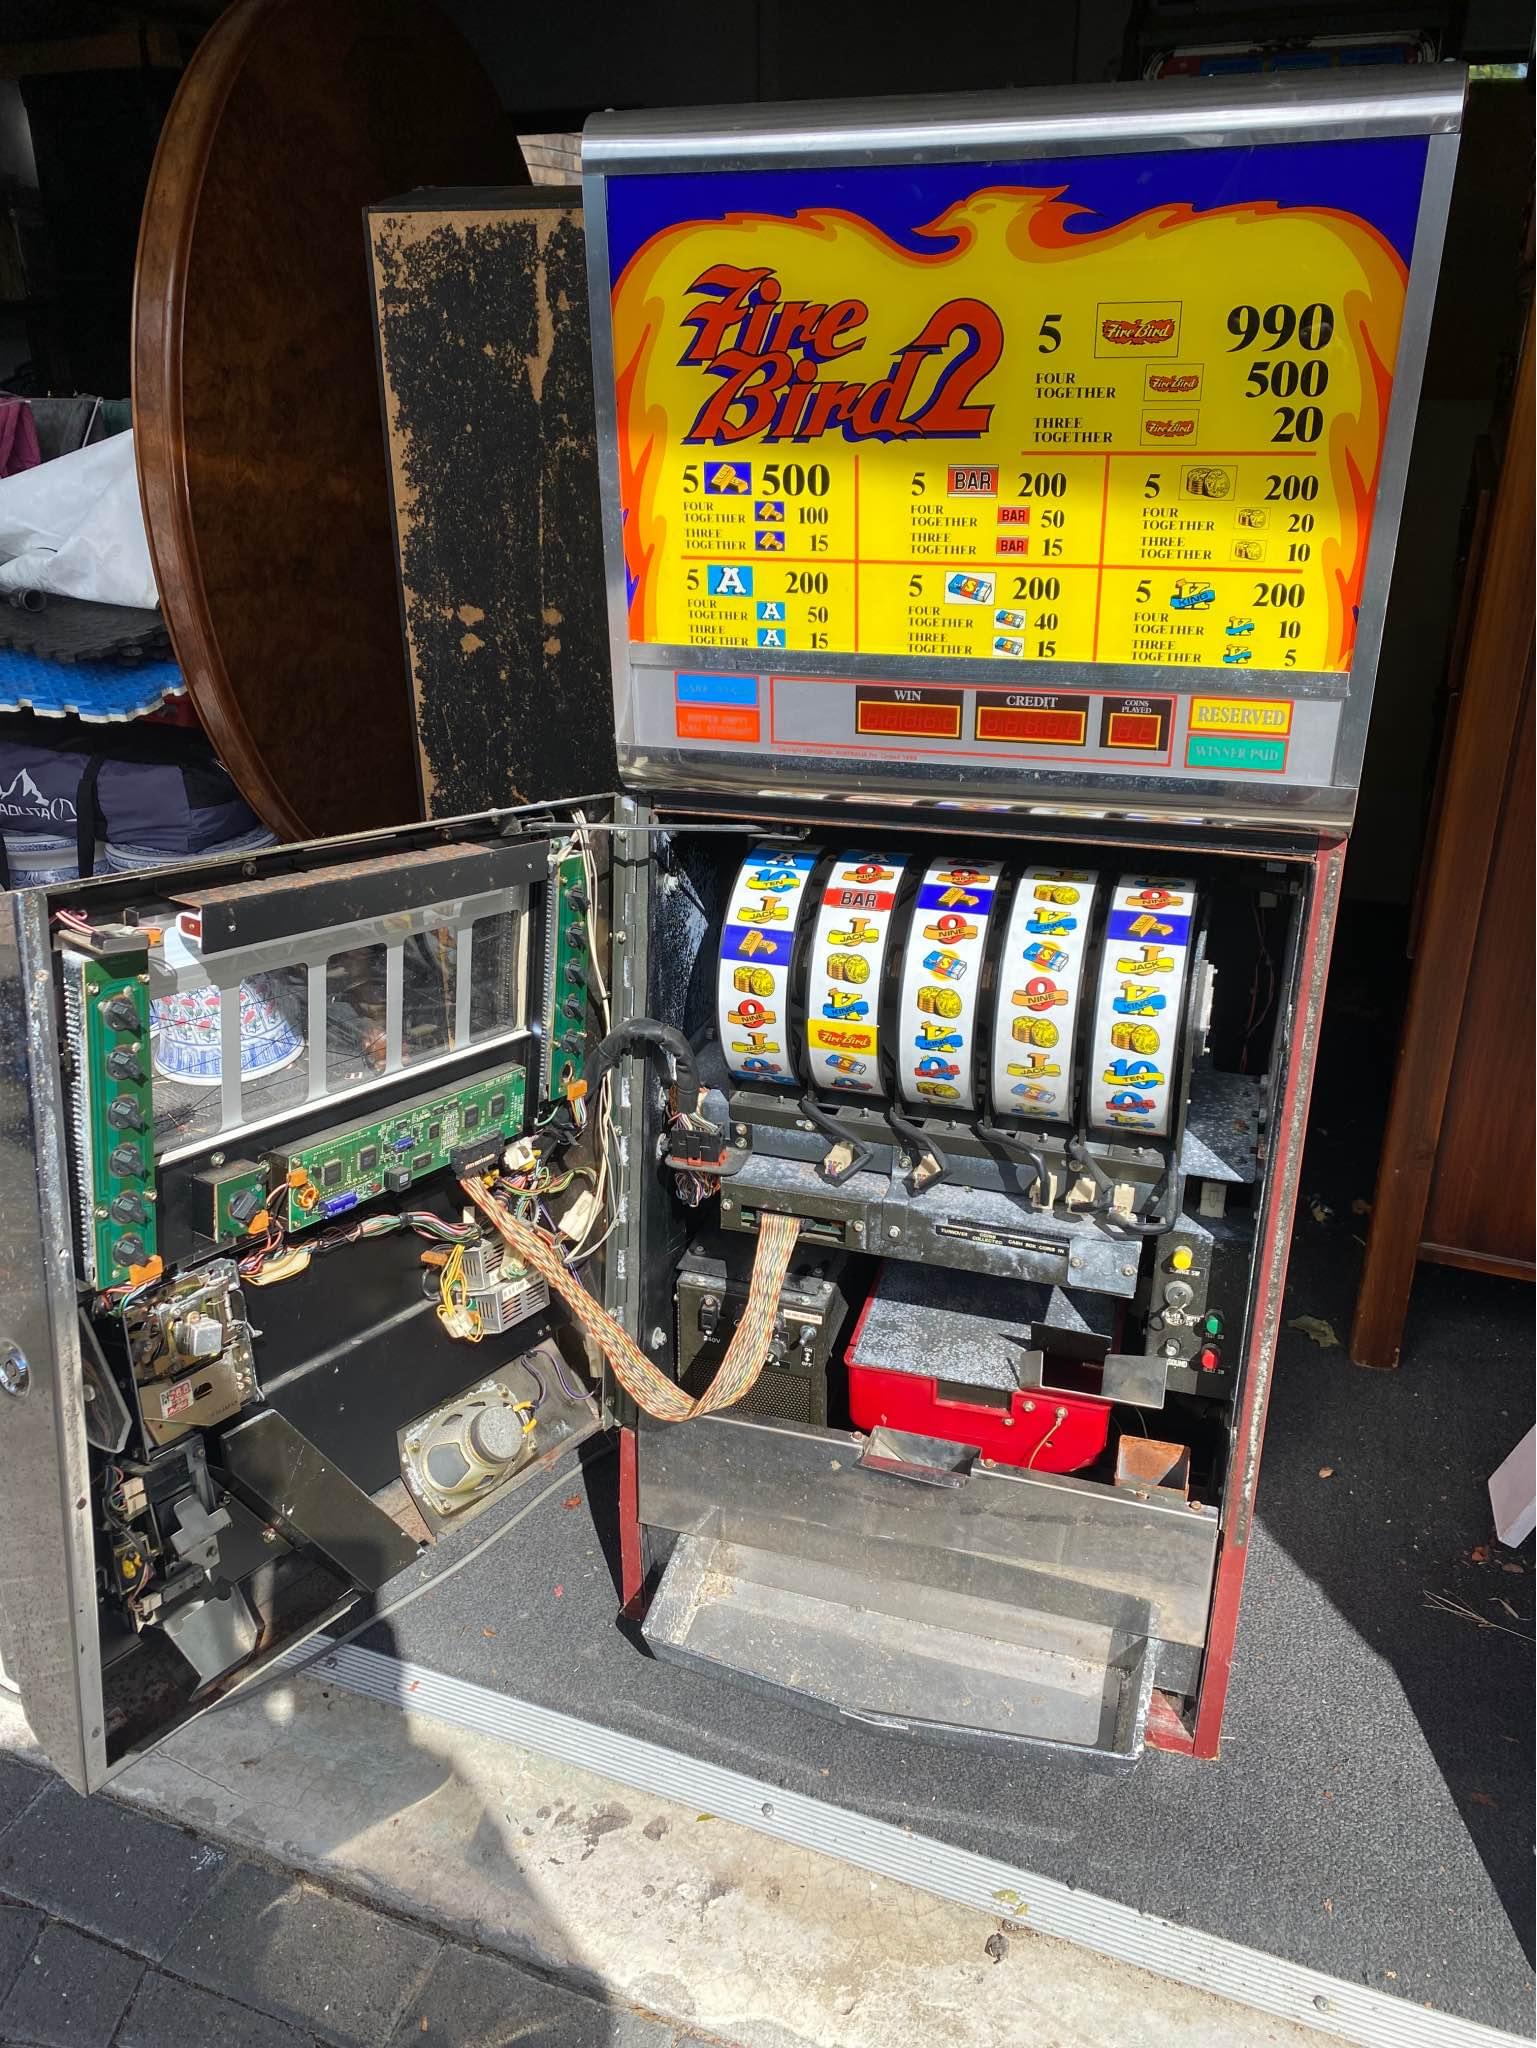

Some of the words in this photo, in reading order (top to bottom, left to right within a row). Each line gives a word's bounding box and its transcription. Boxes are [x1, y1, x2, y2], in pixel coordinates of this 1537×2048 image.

[677, 264, 868, 364] Fire
[1038, 314, 1062, 354] 5
[1107, 324, 1134, 338] Fire
[1134, 324, 1170, 338] Bird
[1226, 303, 1335, 353] 990
[680, 350, 922, 446] Bird
[889, 298, 1004, 439] 2
[1035, 372, 1076, 385] FOUR
[1035, 387, 1116, 399] TOGETHER
[1245, 360, 1329, 398] 500
[1033, 417, 1084, 429] THREE
[1033, 432, 1113, 443] TOGETHER
[1270, 406, 1324, 443] 20
[683, 465, 698, 493] 5
[762, 464, 830, 496] 500
[911, 472, 925, 496] 5
[955, 472, 991, 490] BAR
[1018, 473, 1067, 497] 200
[1144, 473, 1161, 498] 5
[1264, 475, 1319, 500] 200
[684, 502, 713, 511] FOUR
[911, 505, 944, 514] FOUR
[1143, 508, 1179, 518] FOUR
[684, 514, 746, 524] TOGETHER
[800, 507, 828, 524] 100
[912, 517, 977, 527] TOGETHER
[1002, 510, 1025, 522] BAR
[1041, 510, 1064, 528] 50
[1143, 520, 1214, 531] TOGETHER
[1288, 514, 1314, 532] 20
[685, 529, 721, 538] THREE
[911, 533, 951, 542] THREE
[686, 540, 746, 550] TOGETHER
[810, 535, 828, 552] 15
[911, 545, 976, 555] TOGETHER
[1001, 540, 1024, 552] BAR
[1042, 538, 1062, 556] 15
[1141, 537, 1185, 547] THREE
[1141, 550, 1212, 560] TOGETHER
[1288, 544, 1310, 562] 10
[687, 569, 699, 590] 5
[716, 567, 746, 594] A
[786, 571, 828, 594] 200
[909, 574, 923, 597] 5
[1013, 577, 1060, 600] 200
[1136, 580, 1152, 603] 5
[1179, 592, 1209, 606] KING
[1253, 583, 1305, 608] 200
[688, 599, 716, 608] FOUR
[689, 611, 748, 620] TOGETHER
[762, 603, 781, 620] A
[808, 606, 828, 623] 50
[908, 606, 940, 615] FOUR
[1134, 612, 1169, 622] FOUR
[908, 617, 973, 628] TOGETHER
[1034, 613, 1058, 630] 40
[690, 625, 725, 634] THREE
[1133, 624, 1204, 636] TOGETHER
[1280, 620, 1300, 639] 10
[690, 636, 748, 646] TOGETHER
[811, 633, 828, 649] 15
[908, 632, 946, 642] THREE
[908, 644, 972, 654] TOGETHER
[1038, 641, 1056, 658] 15
[1132, 640, 1176, 650] THREE
[1132, 652, 1201, 663] TOGETHER
[1285, 650, 1296, 666] 5
[894, 690, 922, 701] WIN
[1006, 695, 1058, 708] CREDIT
[1122, 706, 1152, 714] PLAYED
[1199, 706, 1286, 726] RESERVED
[1195, 746, 1244, 760] WINNER
[1250, 748, 1278, 761] PAID
[841, 892, 876, 908] BAR
[751, 911, 776, 920] JACK
[1036, 922, 1062, 930] KING
[840, 932, 866, 942] JACK
[938, 928, 965, 938] NINE
[1130, 961, 1158, 971] JACK
[1028, 992, 1055, 1004] NINE
[1124, 999, 1152, 1010] KING
[741, 1014, 764, 1022] NINE
[941, 1228, 968, 1237] TURNOVER
[972, 1236, 1003, 1245] COLLECTED
